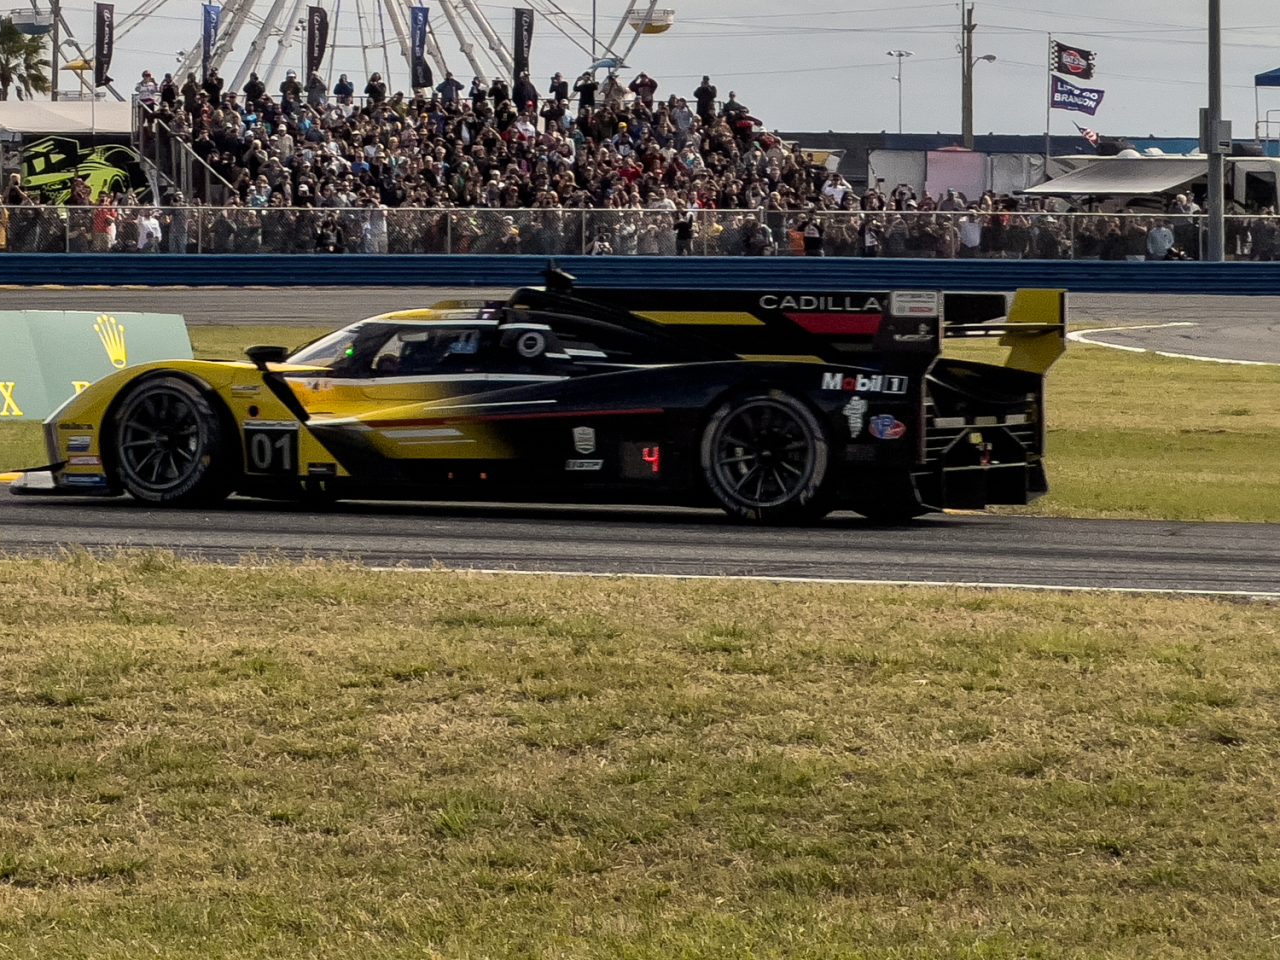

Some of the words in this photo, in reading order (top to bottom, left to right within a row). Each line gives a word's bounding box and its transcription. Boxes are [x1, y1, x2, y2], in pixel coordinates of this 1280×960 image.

[1054, 92, 1096, 108] BRANDON
[759, 295, 888, 311] CADILLA
[822, 372, 883, 392] Mobil
[251, 433, 291, 469] 01
[642, 446, 660, 472] 4
